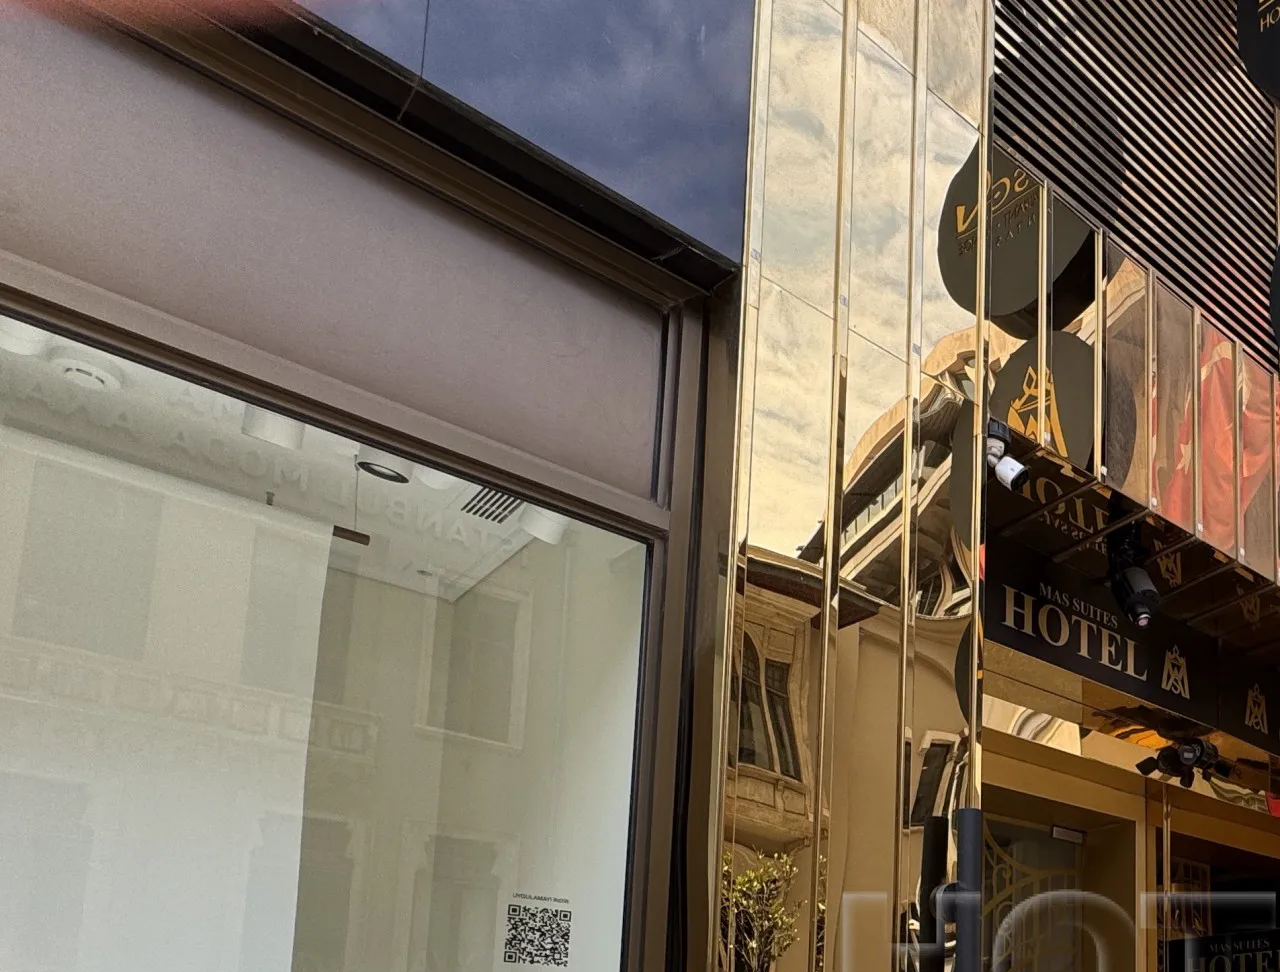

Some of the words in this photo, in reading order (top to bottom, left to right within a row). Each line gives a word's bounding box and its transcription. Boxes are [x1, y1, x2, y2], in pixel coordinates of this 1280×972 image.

[1001, 583, 1149, 682] HOTEL
[1039, 582, 1070, 608] MAS
[1071, 598, 1118, 629] SUITES
